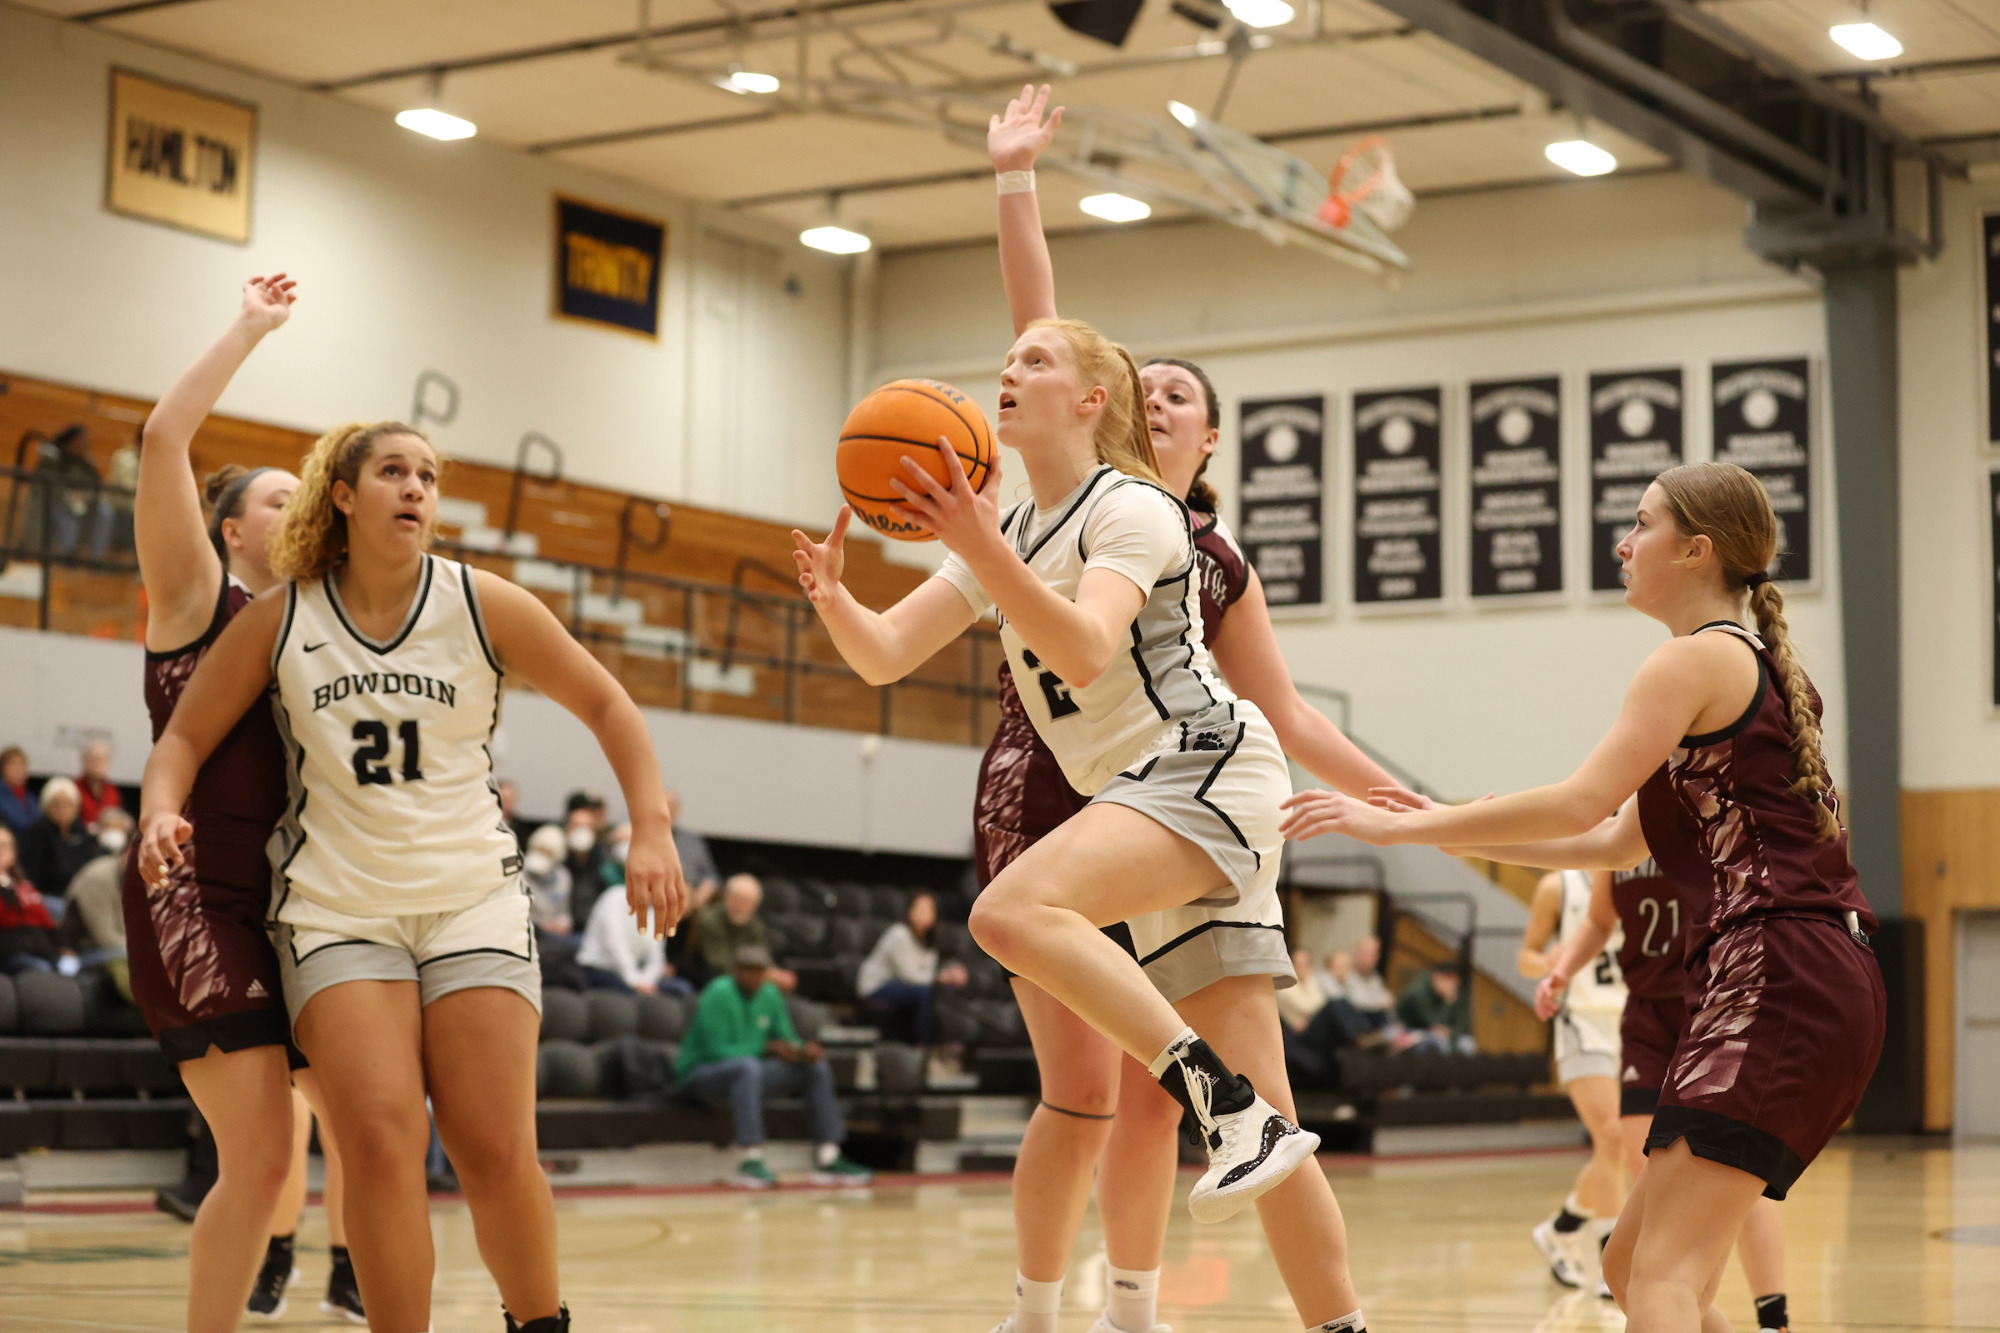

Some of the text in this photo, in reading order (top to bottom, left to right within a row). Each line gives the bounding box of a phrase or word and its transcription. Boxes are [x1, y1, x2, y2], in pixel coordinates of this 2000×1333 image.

[853, 504, 922, 532] Wilso
[312, 672, 456, 712] BOWDOIN
[351, 719, 425, 786] 21
[1638, 897, 1680, 957] 21
